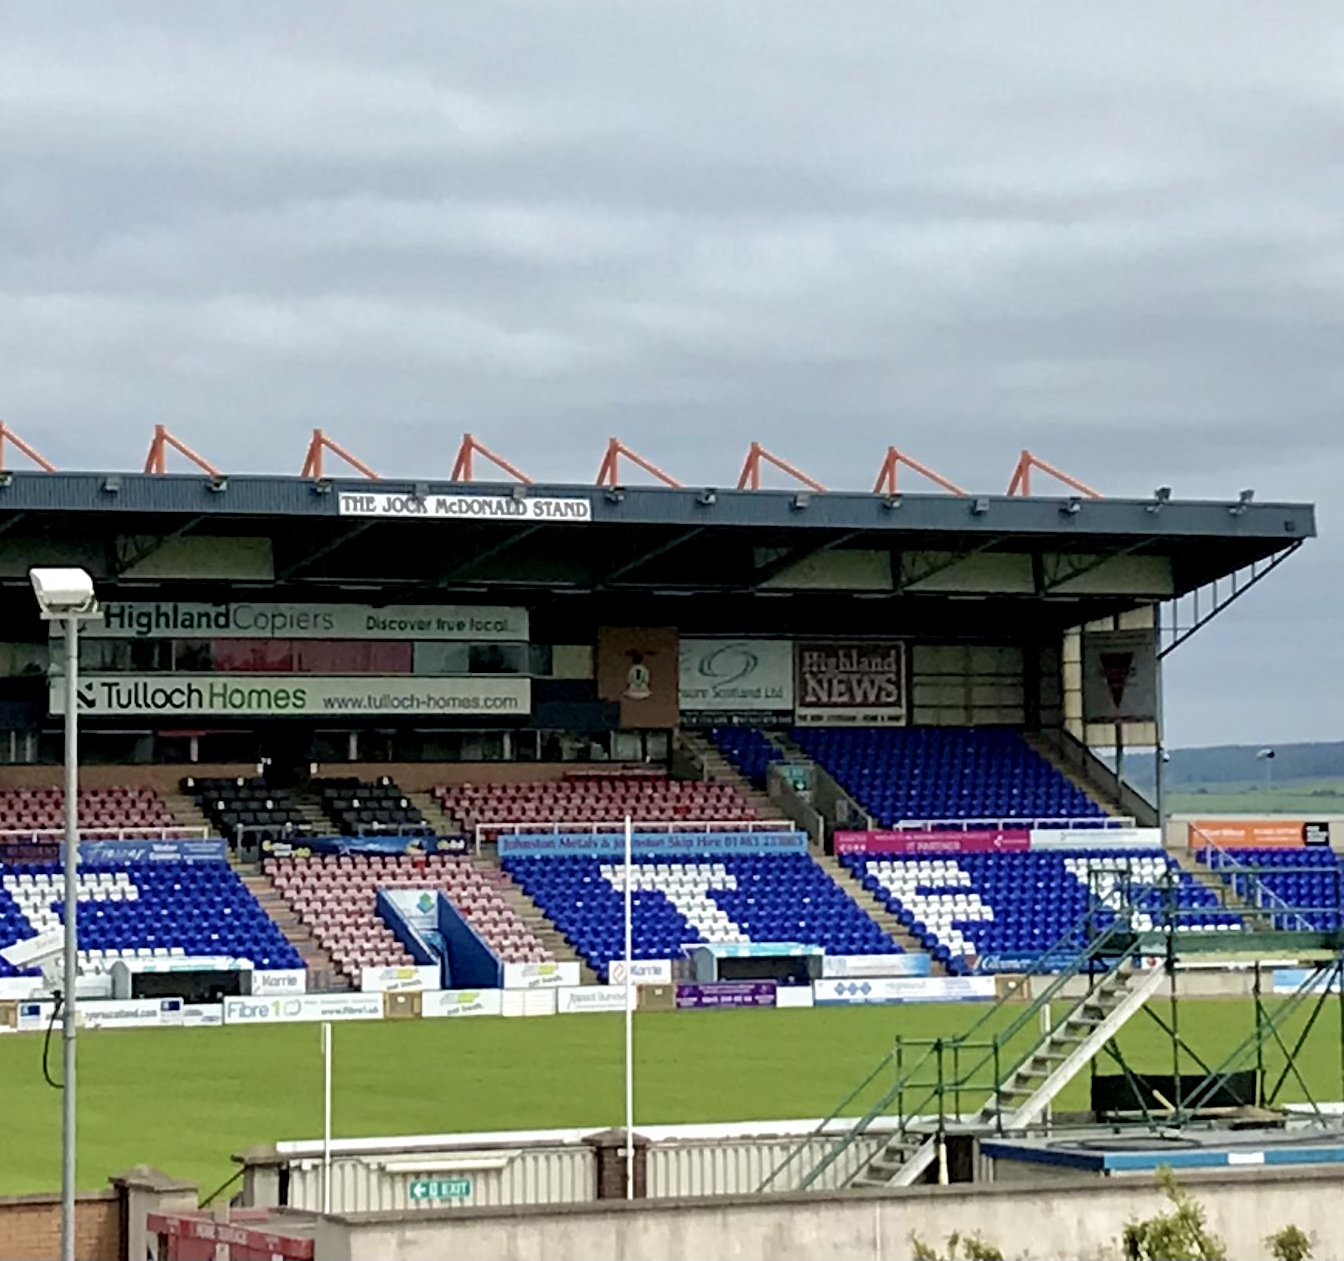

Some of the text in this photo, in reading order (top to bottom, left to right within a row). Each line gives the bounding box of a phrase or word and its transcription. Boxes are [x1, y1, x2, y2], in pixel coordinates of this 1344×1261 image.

[342, 496, 588, 517] THE JOCK McDONALD STAND
[366, 616, 431, 631] Discover
[436, 618, 466, 631] true
[802, 649, 896, 675] Highland
[100, 682, 307, 709] Tulloch Homes
[712, 686, 762, 699] Scotland
[805, 673, 899, 704] NEWS
[323, 694, 517, 709] www.tulloch-homes.com
[697, 836, 721, 847] Hire
[262, 974, 298, 987] Korrie
